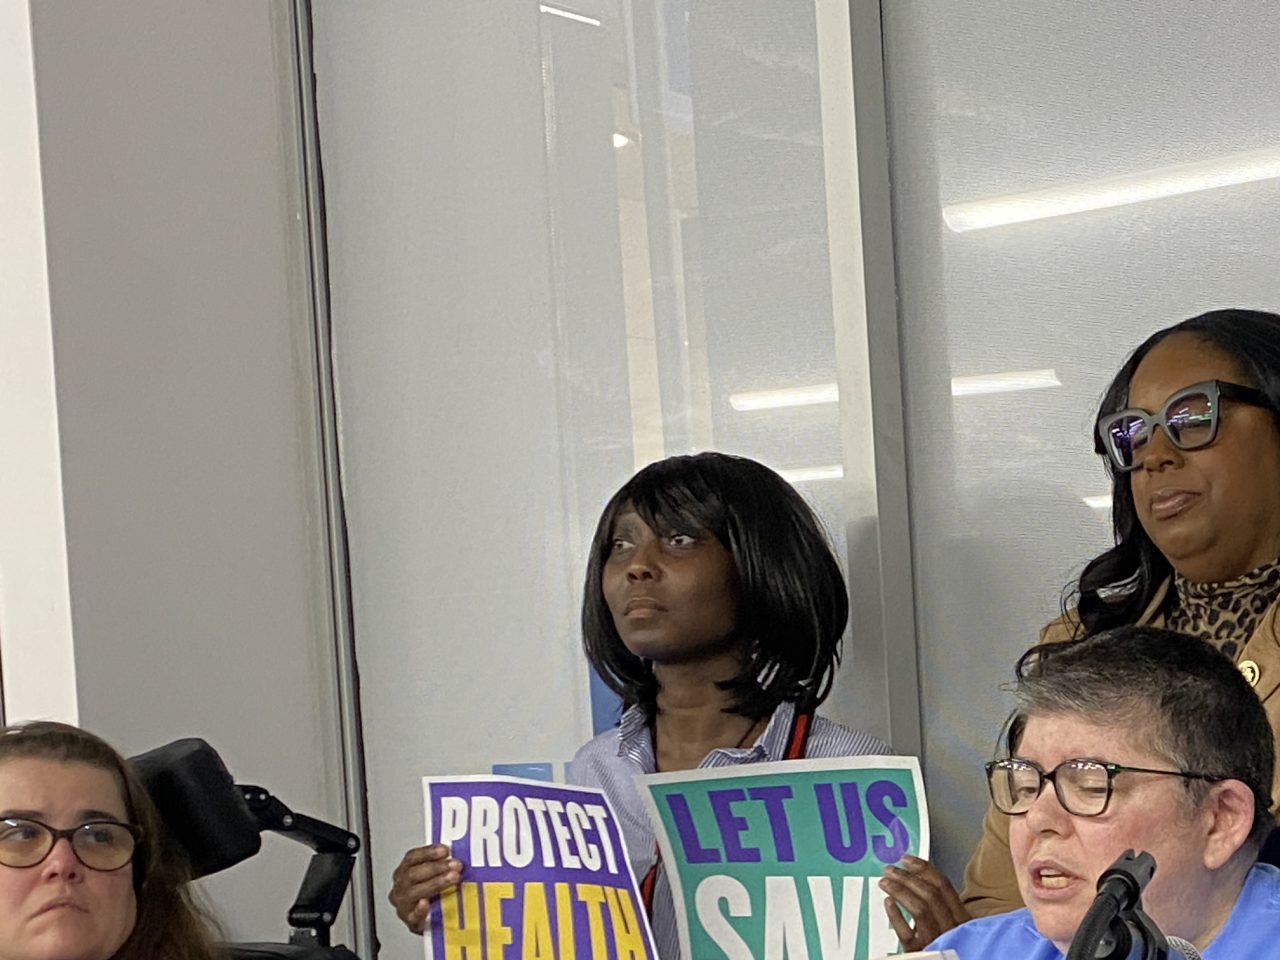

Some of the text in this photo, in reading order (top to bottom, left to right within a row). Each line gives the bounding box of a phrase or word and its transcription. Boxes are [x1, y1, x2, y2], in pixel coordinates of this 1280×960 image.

[440, 795, 618, 874] PROTECT
[665, 779, 910, 864] LET US
